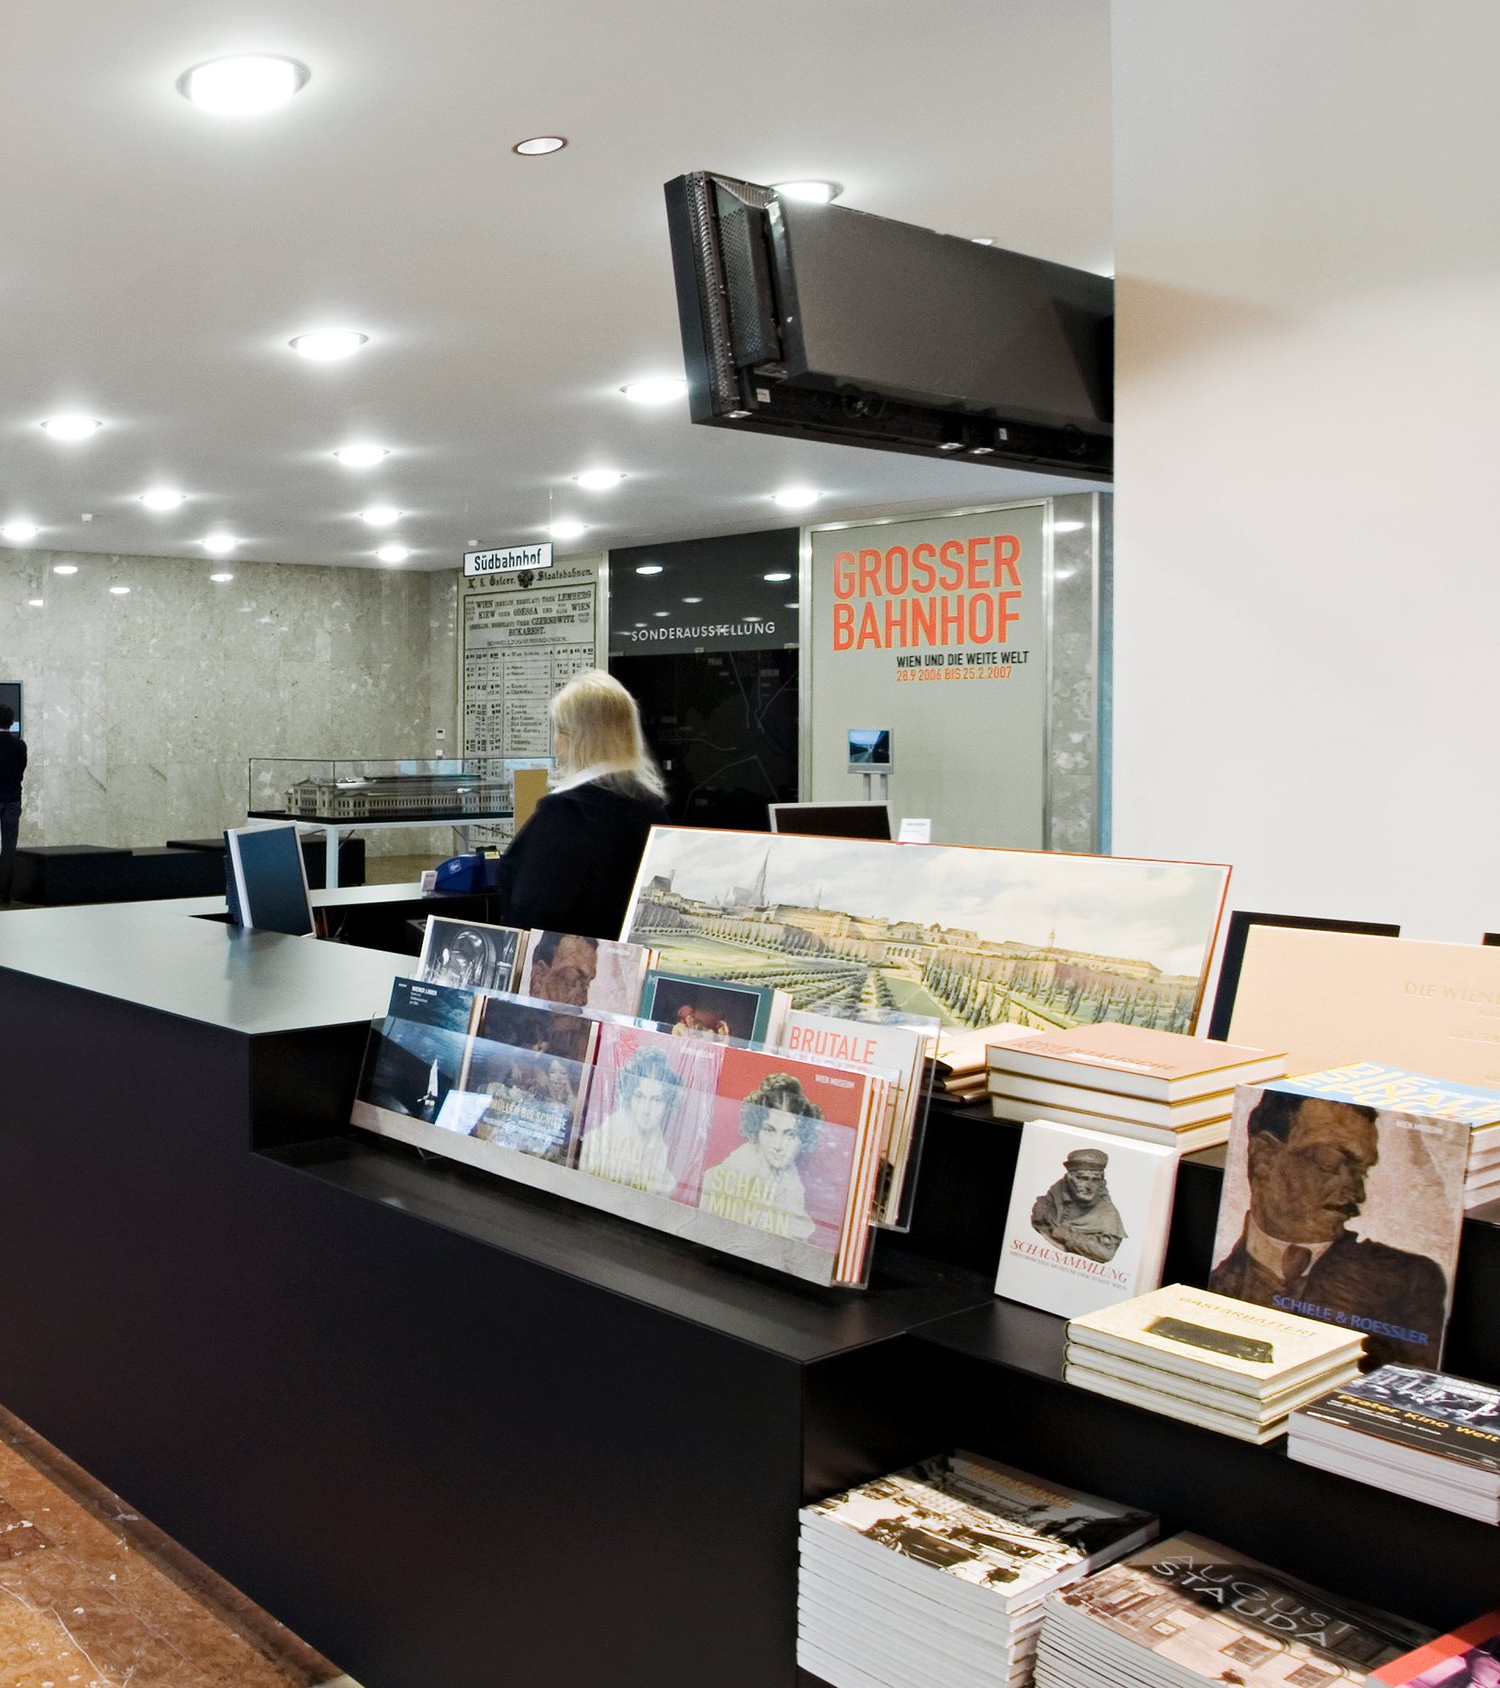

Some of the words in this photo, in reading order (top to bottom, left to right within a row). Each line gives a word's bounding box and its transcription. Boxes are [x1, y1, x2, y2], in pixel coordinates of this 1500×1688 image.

[474, 548, 542, 571] Südbahnhof
[833, 534, 1022, 600] GROSSER
[513, 607, 538, 616] ODESSA
[631, 621, 776, 641] SONDERAUSSTELLUNG
[833, 590, 1022, 651] BAHNHOF
[896, 655, 922, 668] WIEN
[924, 654, 945, 667] UND
[947, 653, 963, 666] DIE
[966, 652, 998, 665] WEITE
[1000, 650, 1029, 664] WELT
[944, 667, 961, 681] BIS
[789, 1026, 877, 1064] BRUTALE
[711, 1166, 778, 1207] SCHAU
[1010, 1239, 1130, 1284] SCHAUSAMMLUNG
[1272, 1294, 1333, 1321] SCHIELE
[1335, 1311, 1347, 1325] &
[1350, 1314, 1429, 1346] ROESSLER
[1337, 1394, 1400, 1415] Prater
[1403, 1411, 1450, 1429] Kino
[1455, 1426, 1500, 1443] Welt
[1151, 1561, 1328, 1647] STAUDA
[1164, 1555, 1360, 1635] AUGUST
